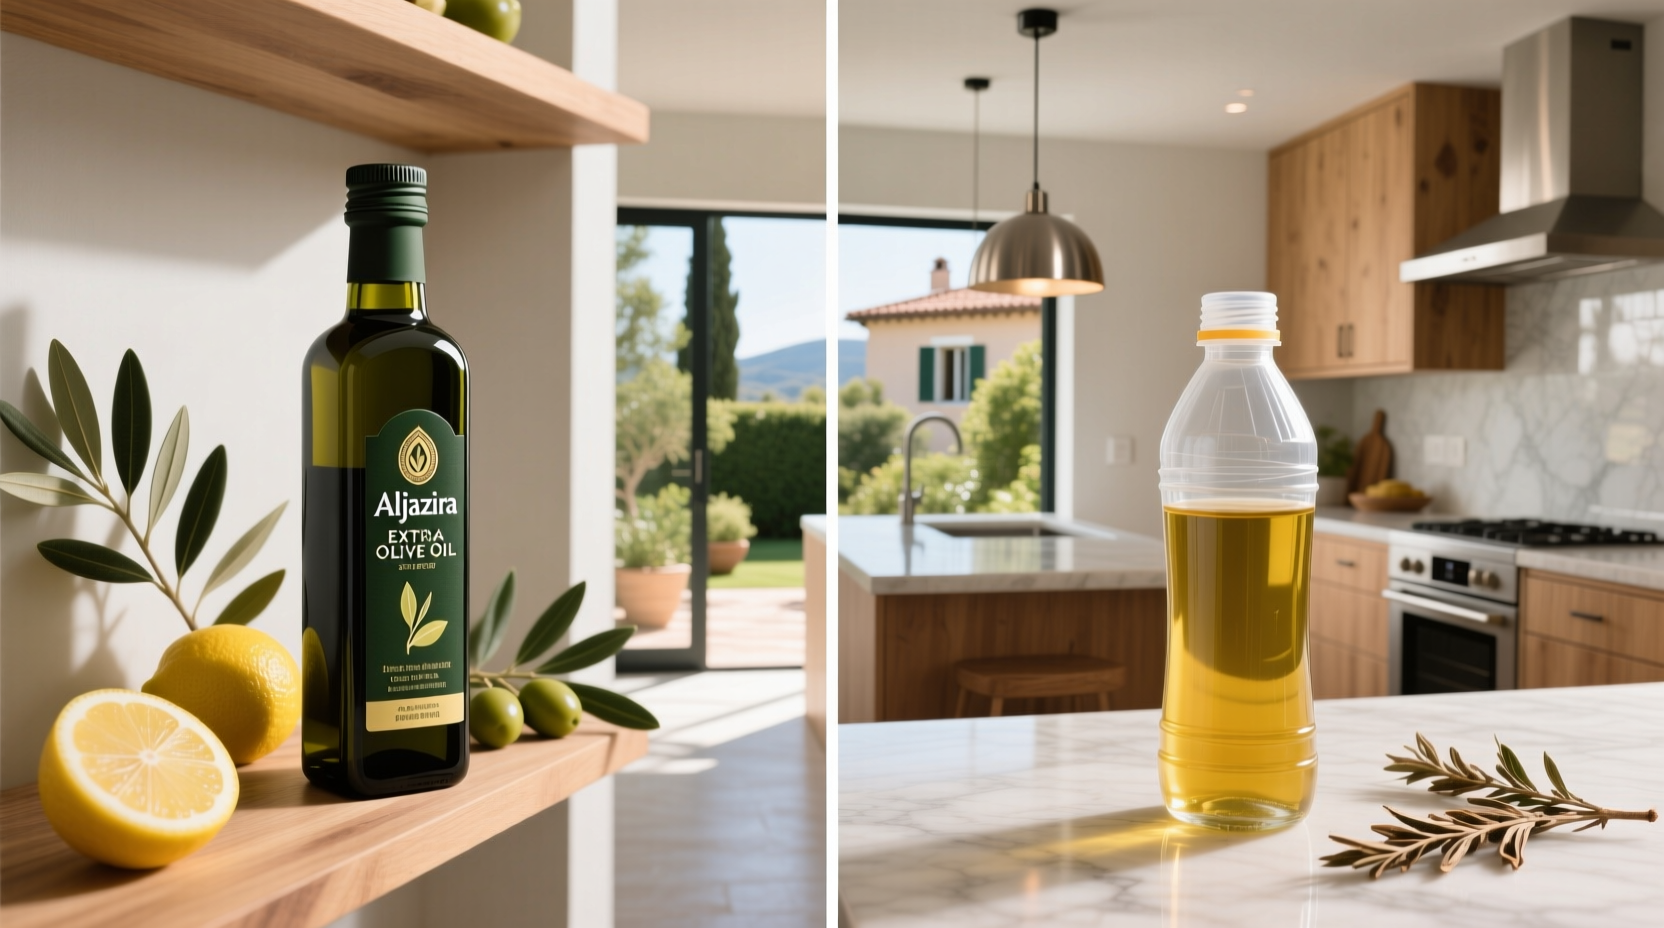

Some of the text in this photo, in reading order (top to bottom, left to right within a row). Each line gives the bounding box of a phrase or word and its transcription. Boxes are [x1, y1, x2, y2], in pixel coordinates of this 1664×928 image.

[373, 491, 458, 524] Aljazira
[376, 542, 457, 560] OLIVE OIL
